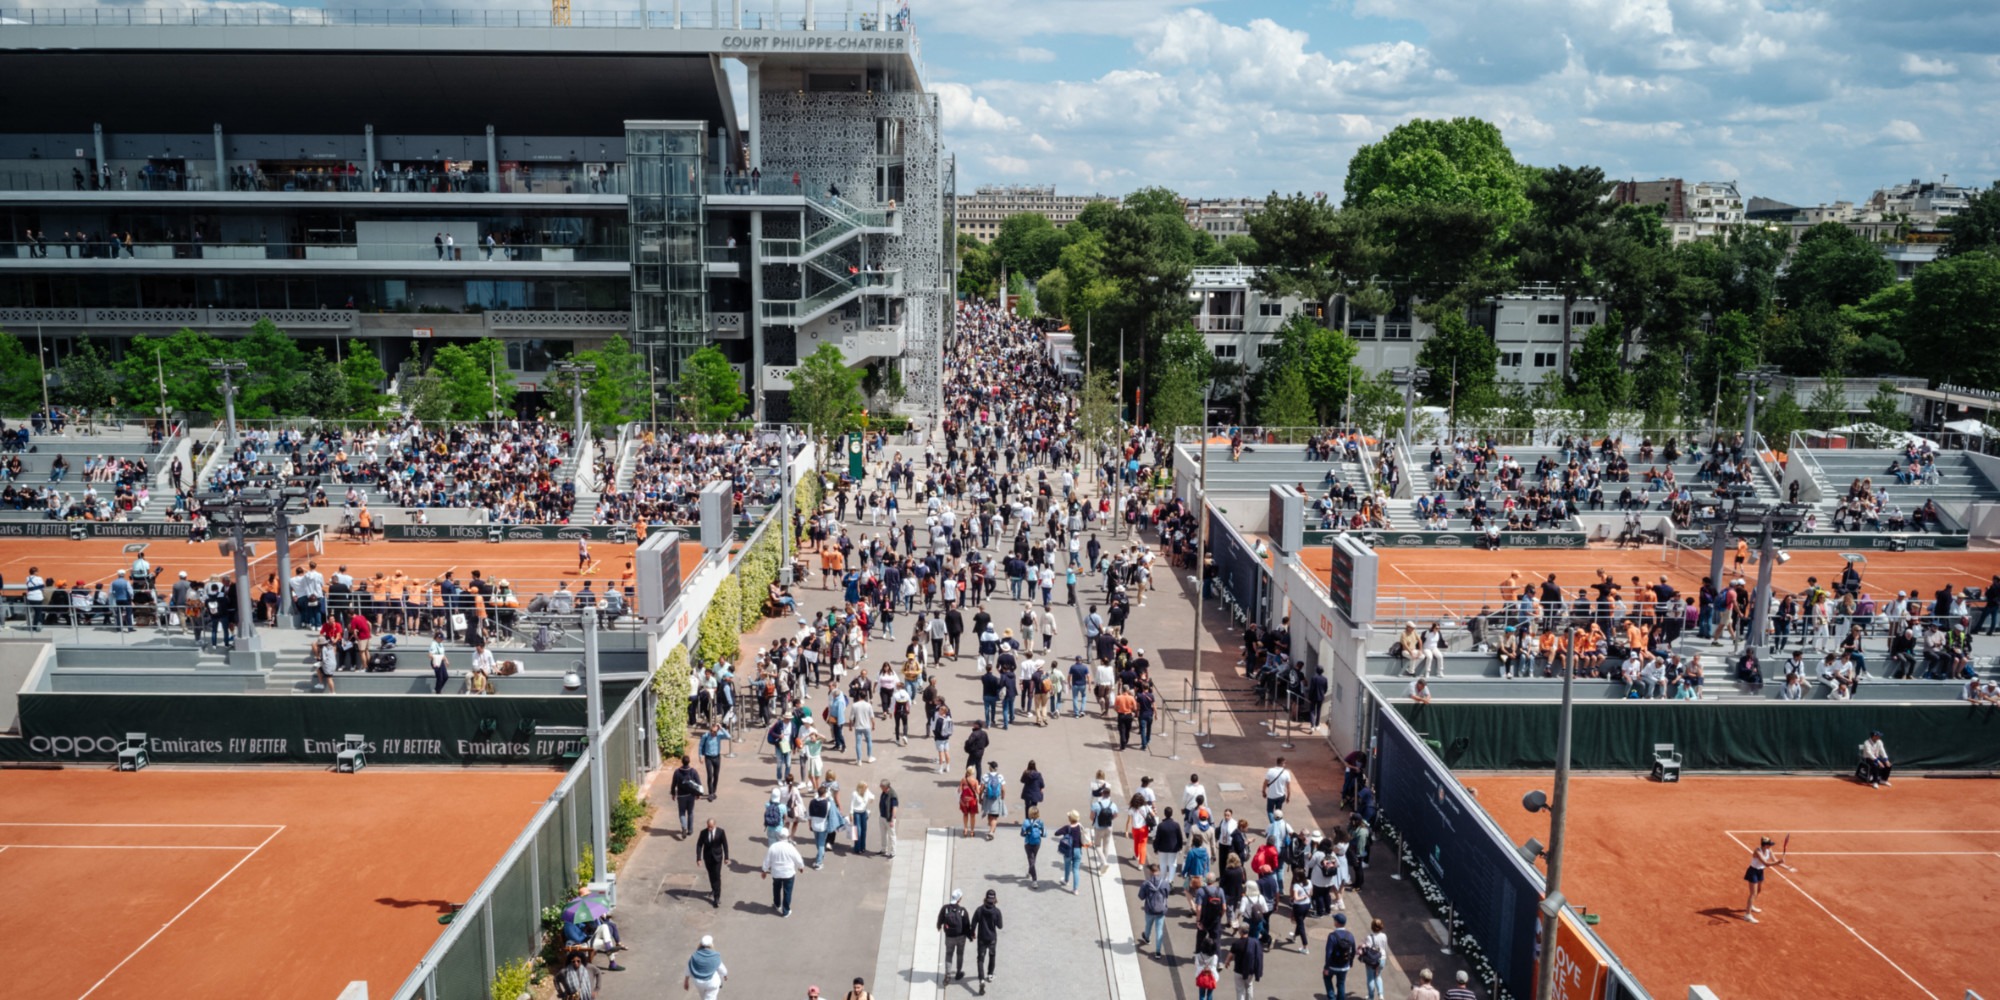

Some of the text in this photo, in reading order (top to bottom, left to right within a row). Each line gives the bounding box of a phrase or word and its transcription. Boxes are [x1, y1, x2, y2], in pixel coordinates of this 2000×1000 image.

[722, 36, 904, 49] COURT PHILIPPE-CHATRIER
[26, 523, 39, 535] FLY
[41, 523, 67, 535] BETTER
[94, 524, 190, 536] Emirates FLY BETTER
[403, 525, 437, 537] Infosys
[449, 525, 484, 538] Infosys
[1509, 535, 1537, 545] Infosys
[1547, 535, 1575, 545] Infosys
[1787, 538, 1821, 547] Emirates
[29, 736, 118, 757] oppo
[149, 738, 287, 753] Emirates FLY BETTER
[383, 739, 401, 754] FLY
[403, 739, 441, 754] BETTER
[457, 739, 587, 755] Emirates FLY BETT
[1556, 945, 1582, 989] OVE
